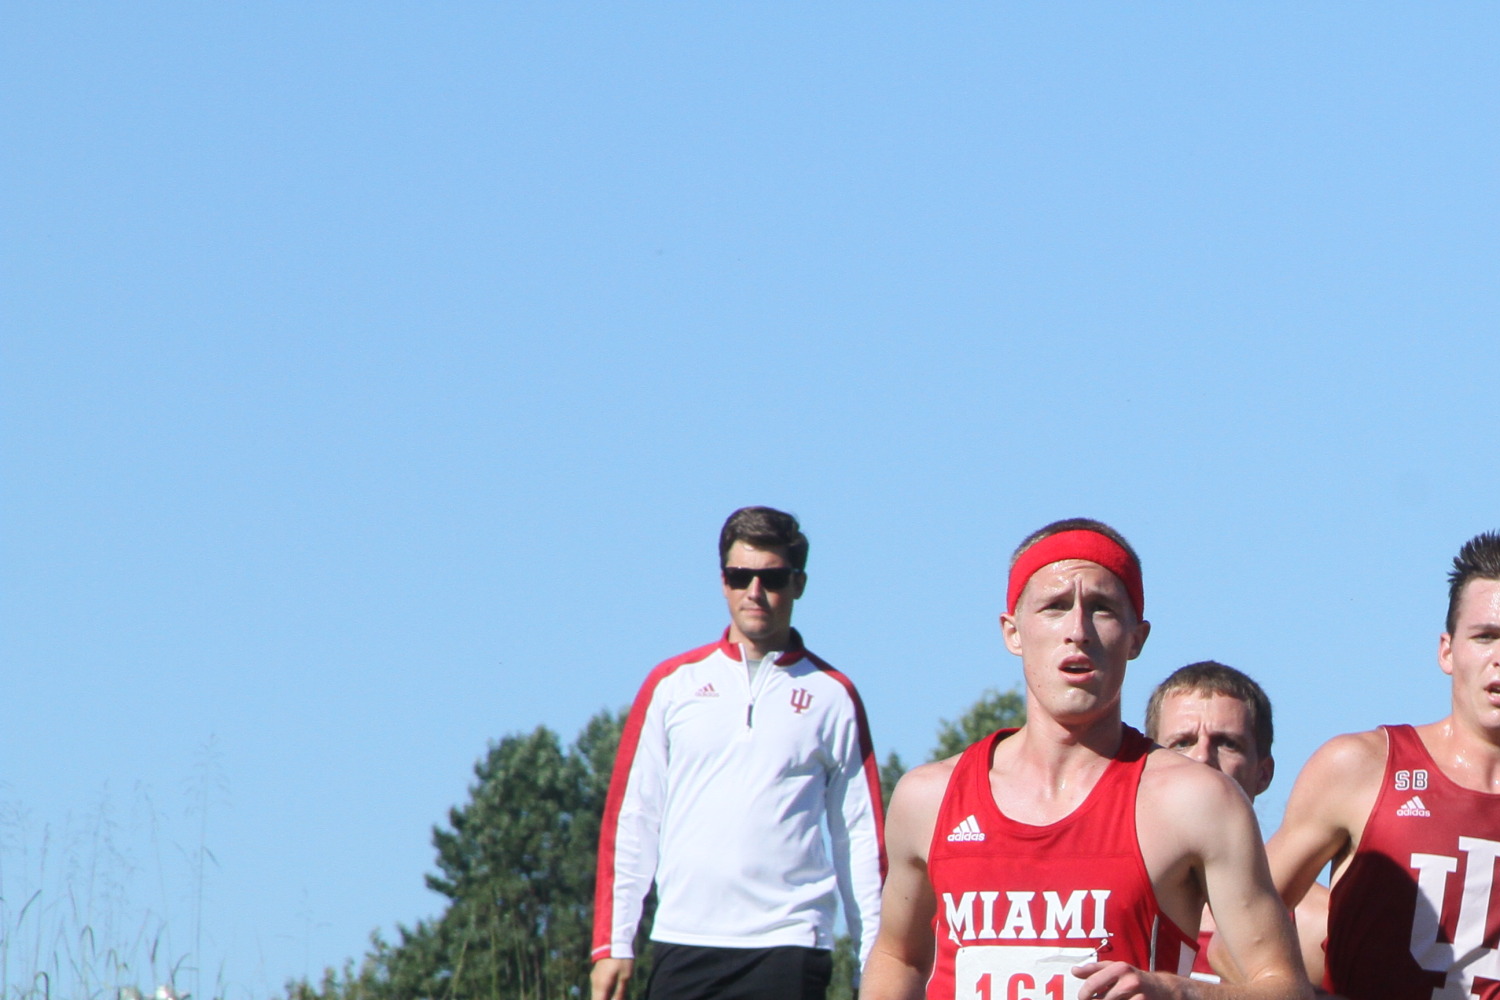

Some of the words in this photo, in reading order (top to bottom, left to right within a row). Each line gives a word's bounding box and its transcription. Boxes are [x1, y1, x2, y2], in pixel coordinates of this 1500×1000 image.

[1394, 769, 1428, 791] SB
[1396, 808, 1430, 818] adidas
[947, 831, 985, 842] adidas
[942, 889, 1112, 940] MIAMI
